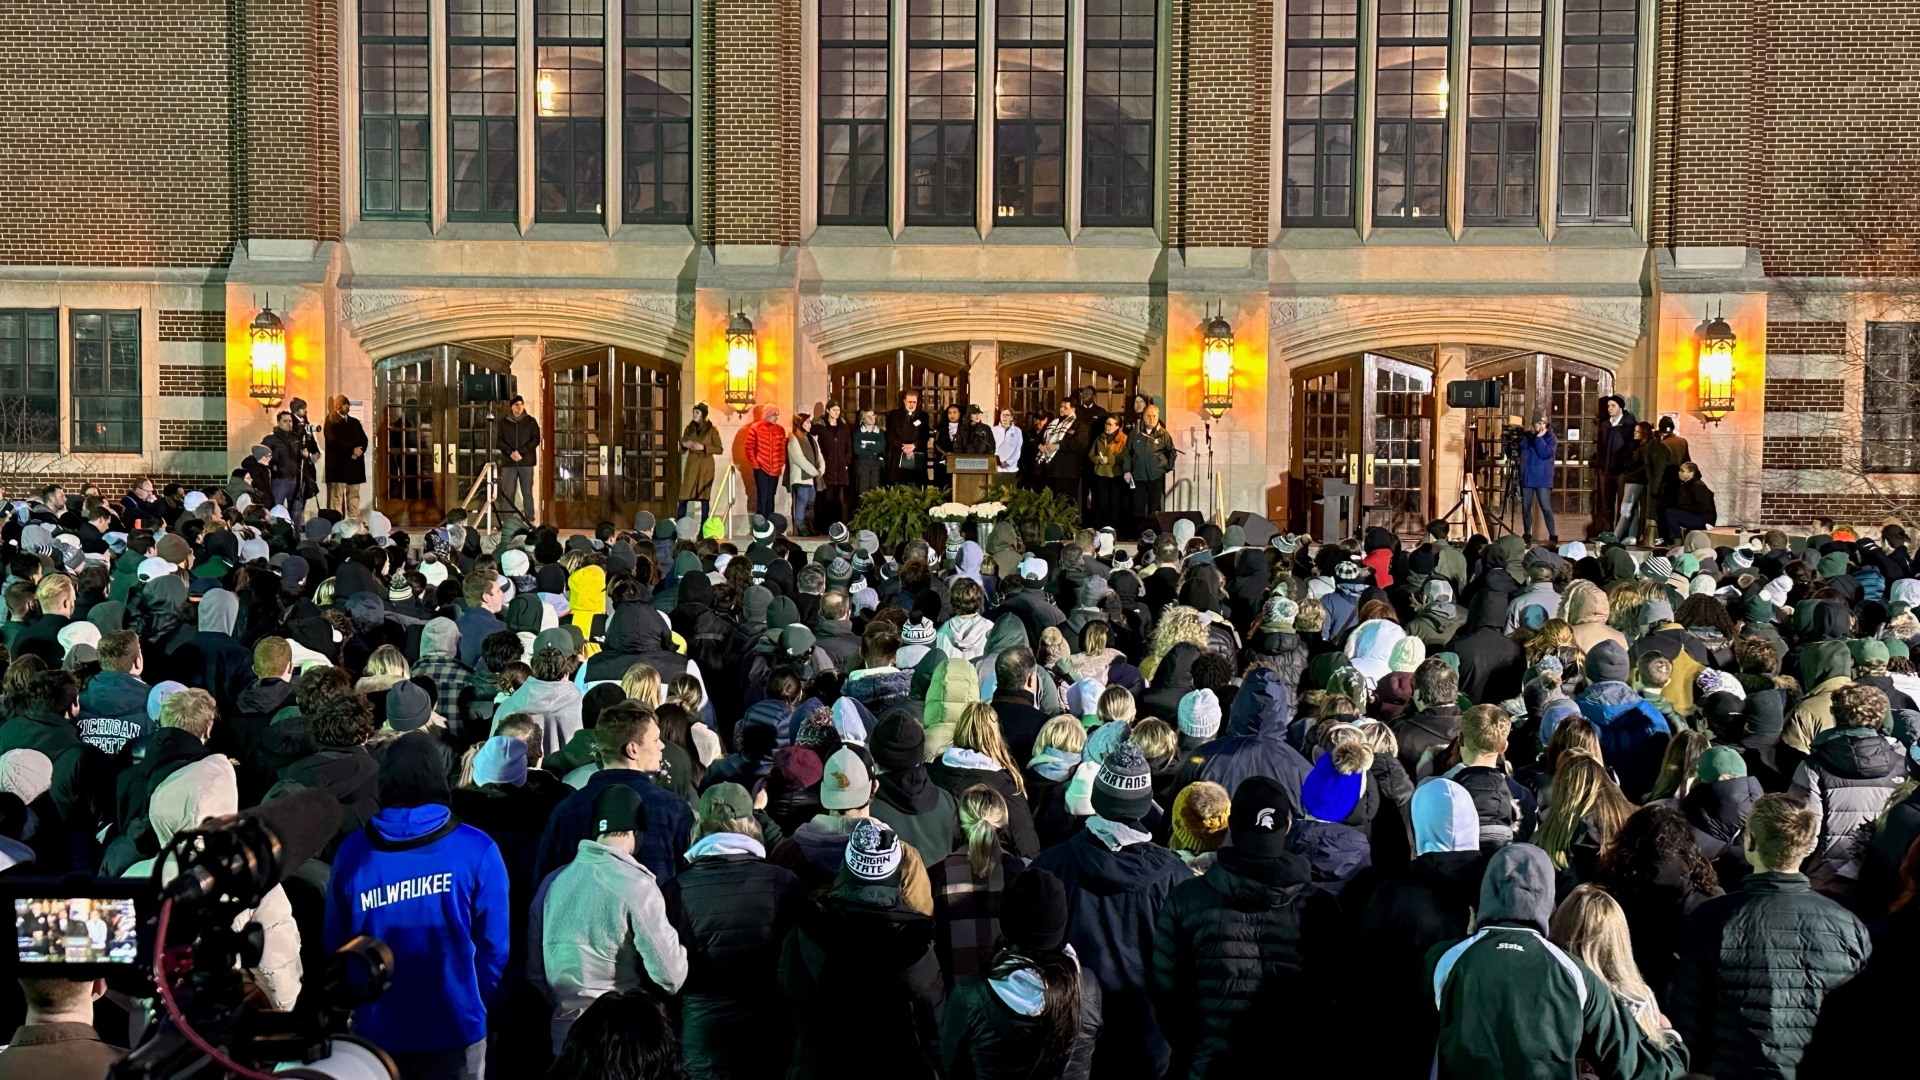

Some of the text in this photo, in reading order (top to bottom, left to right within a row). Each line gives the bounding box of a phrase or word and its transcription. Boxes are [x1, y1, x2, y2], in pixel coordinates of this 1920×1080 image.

[1100, 763, 1147, 789] PARTANS
[599, 819, 608, 832] S
[849, 858, 884, 874] STATE
[360, 872, 453, 912] MILWAUKEE
[1496, 942, 1525, 951] State
